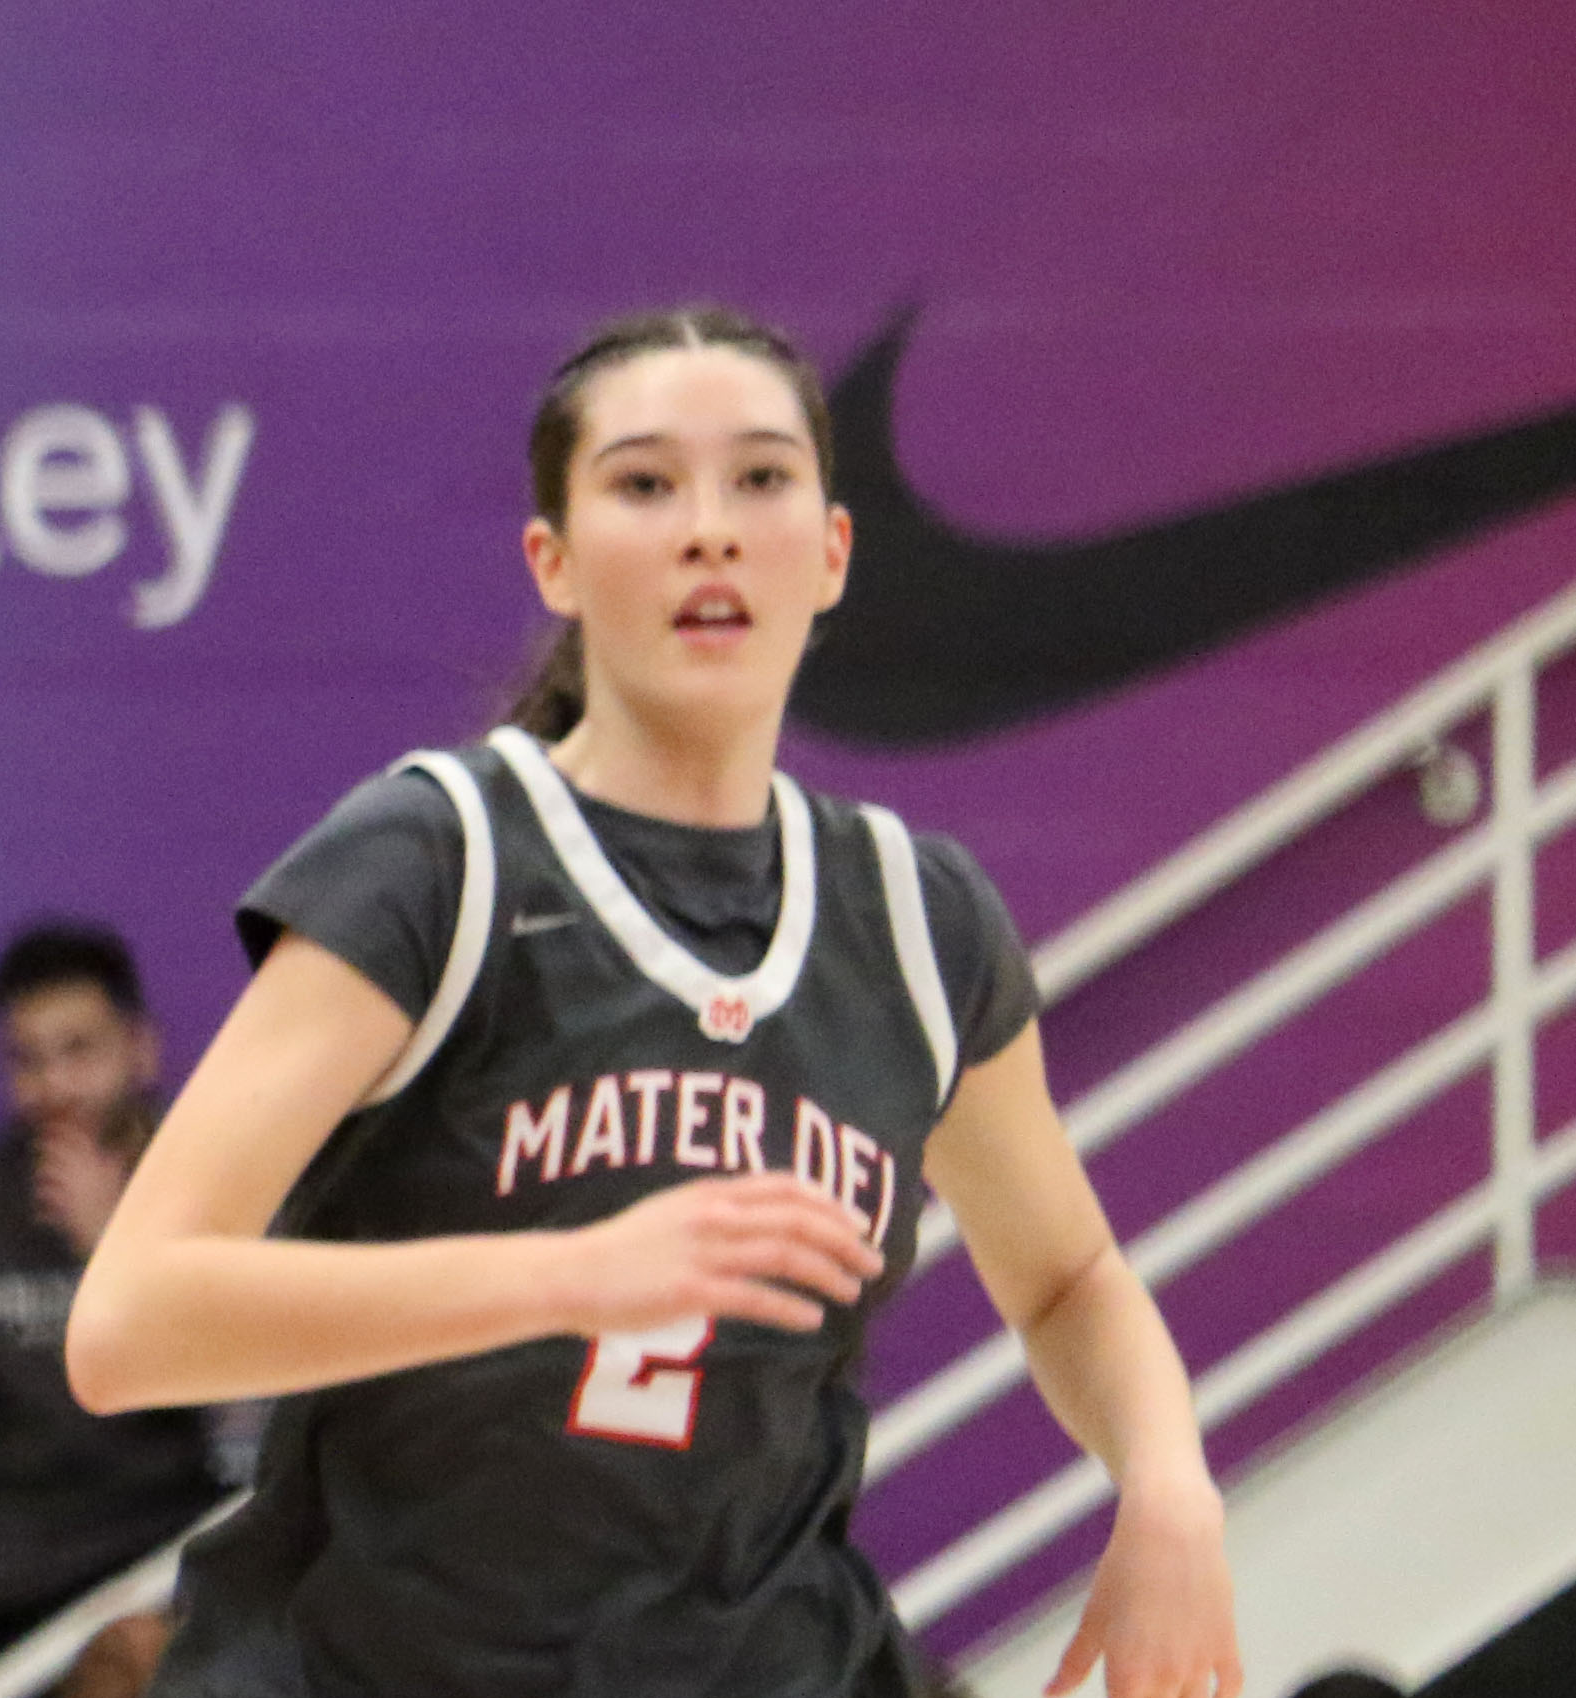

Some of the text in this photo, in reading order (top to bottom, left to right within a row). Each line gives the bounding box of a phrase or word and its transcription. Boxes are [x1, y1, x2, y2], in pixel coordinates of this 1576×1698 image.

[497, 1069, 895, 1249] MATER DEI
[566, 1315, 715, 1450] 2
